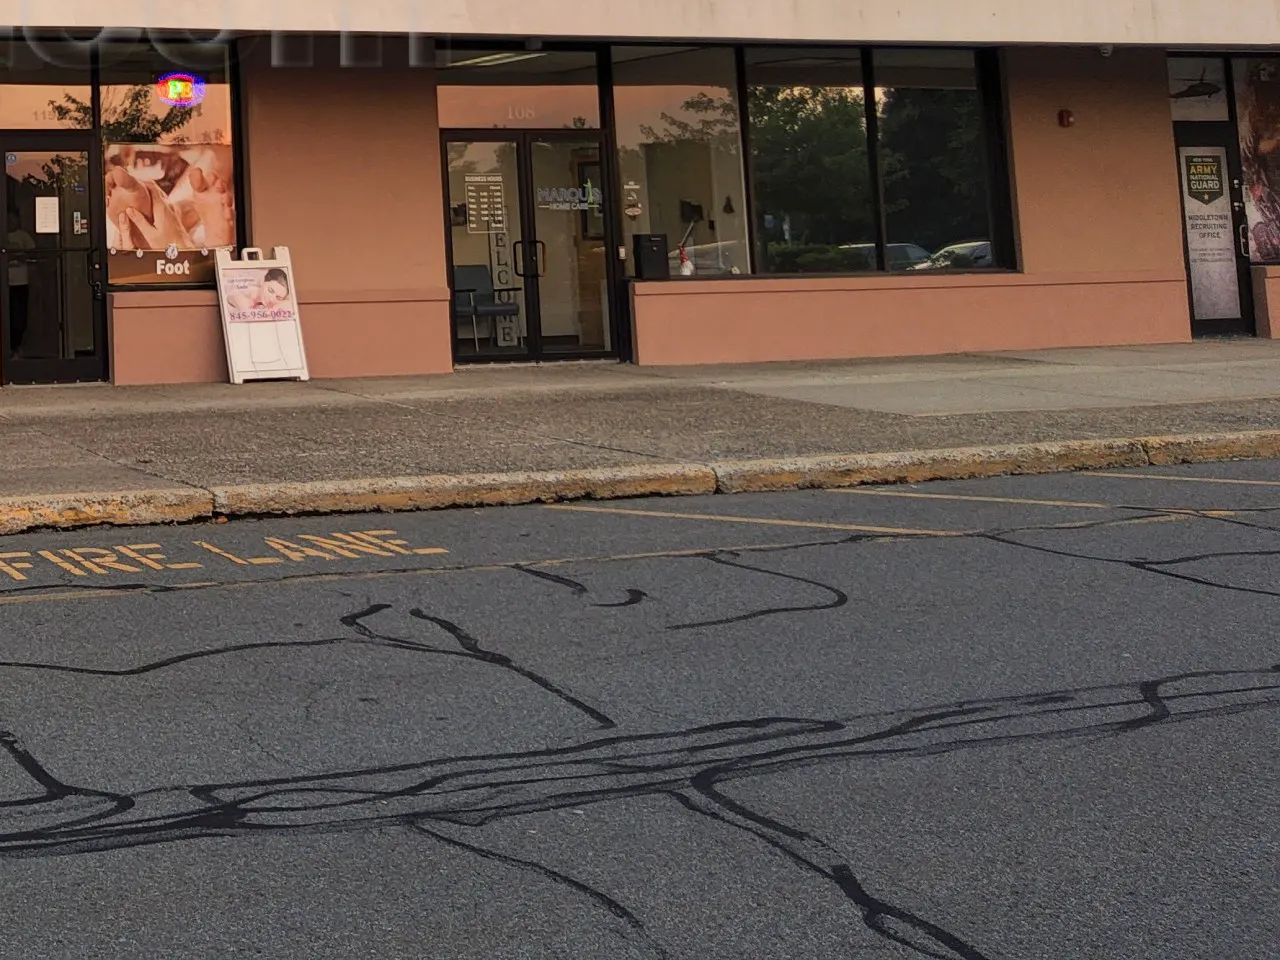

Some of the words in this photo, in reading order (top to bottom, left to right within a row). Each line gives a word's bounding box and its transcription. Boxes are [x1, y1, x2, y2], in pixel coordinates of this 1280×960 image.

[1190, 165, 1217, 174] ARMY
[1190, 180, 1219, 189] GUARD
[156, 259, 190, 276] Foot
[494, 220, 513, 342] ELCOME
[194, 528, 449, 566] LANE
